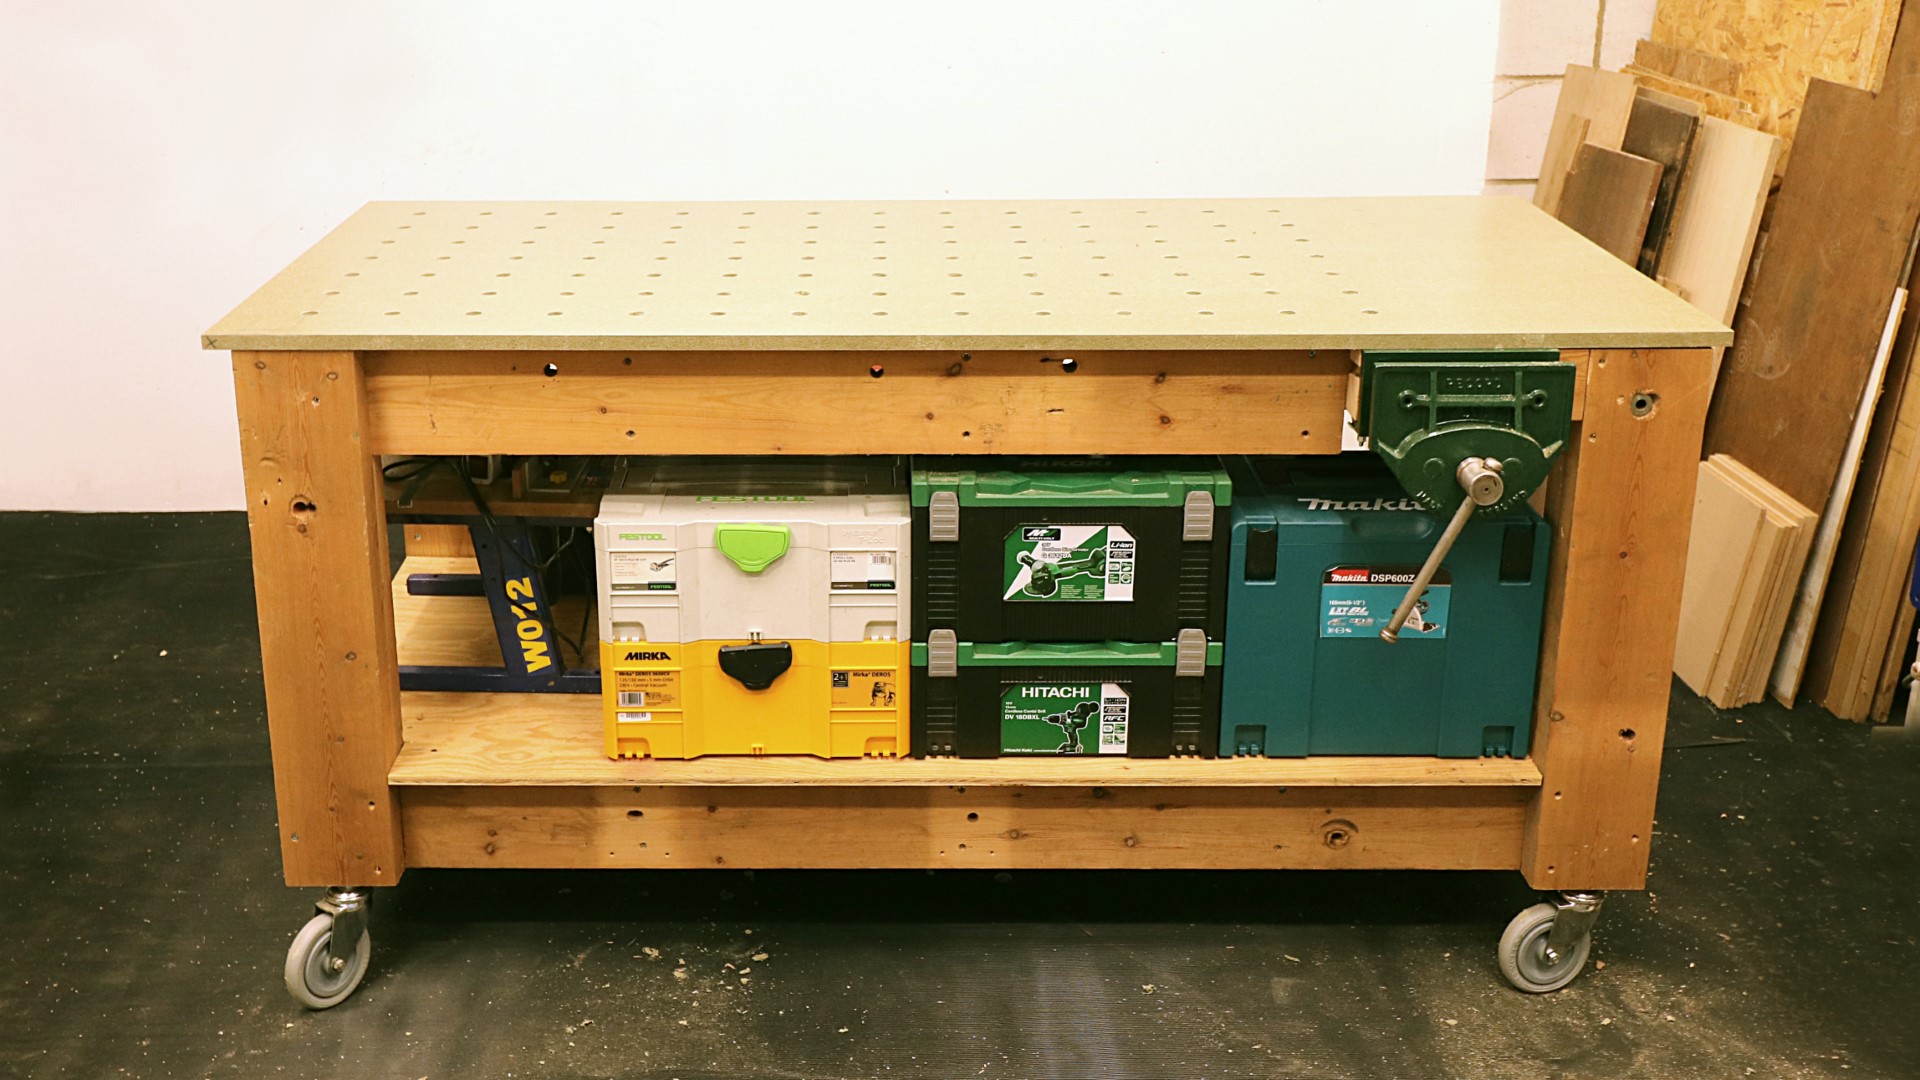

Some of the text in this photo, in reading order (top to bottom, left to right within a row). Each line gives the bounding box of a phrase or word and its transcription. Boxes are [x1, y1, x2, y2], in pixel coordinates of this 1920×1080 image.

[618, 533, 667, 541] FESTOOL
[1331, 574, 1368, 582] makita
[624, 651, 672, 661] MIRKA
[1022, 686, 1090, 698] HITACHI
